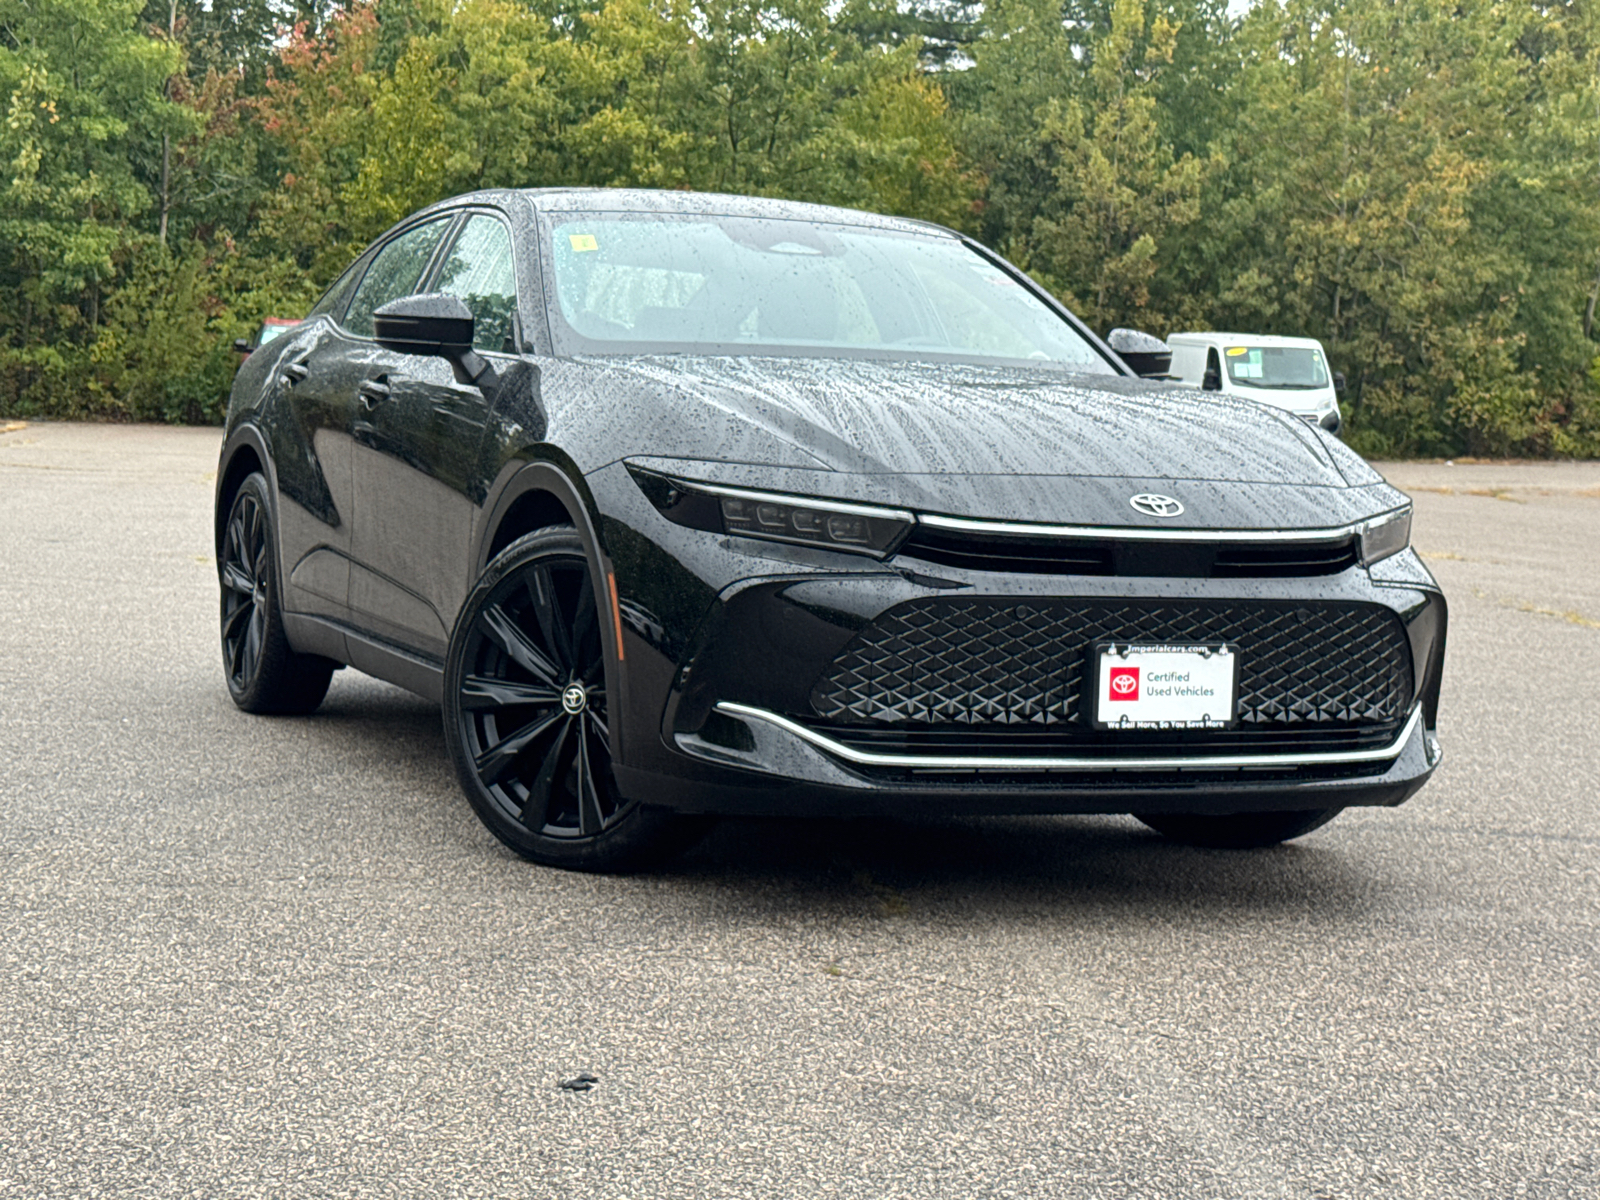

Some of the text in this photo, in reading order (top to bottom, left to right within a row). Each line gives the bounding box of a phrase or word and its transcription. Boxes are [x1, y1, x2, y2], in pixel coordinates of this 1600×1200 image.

[1147, 671, 1190, 682] Certified
[1146, 686, 1214, 696] Used Vehicles
